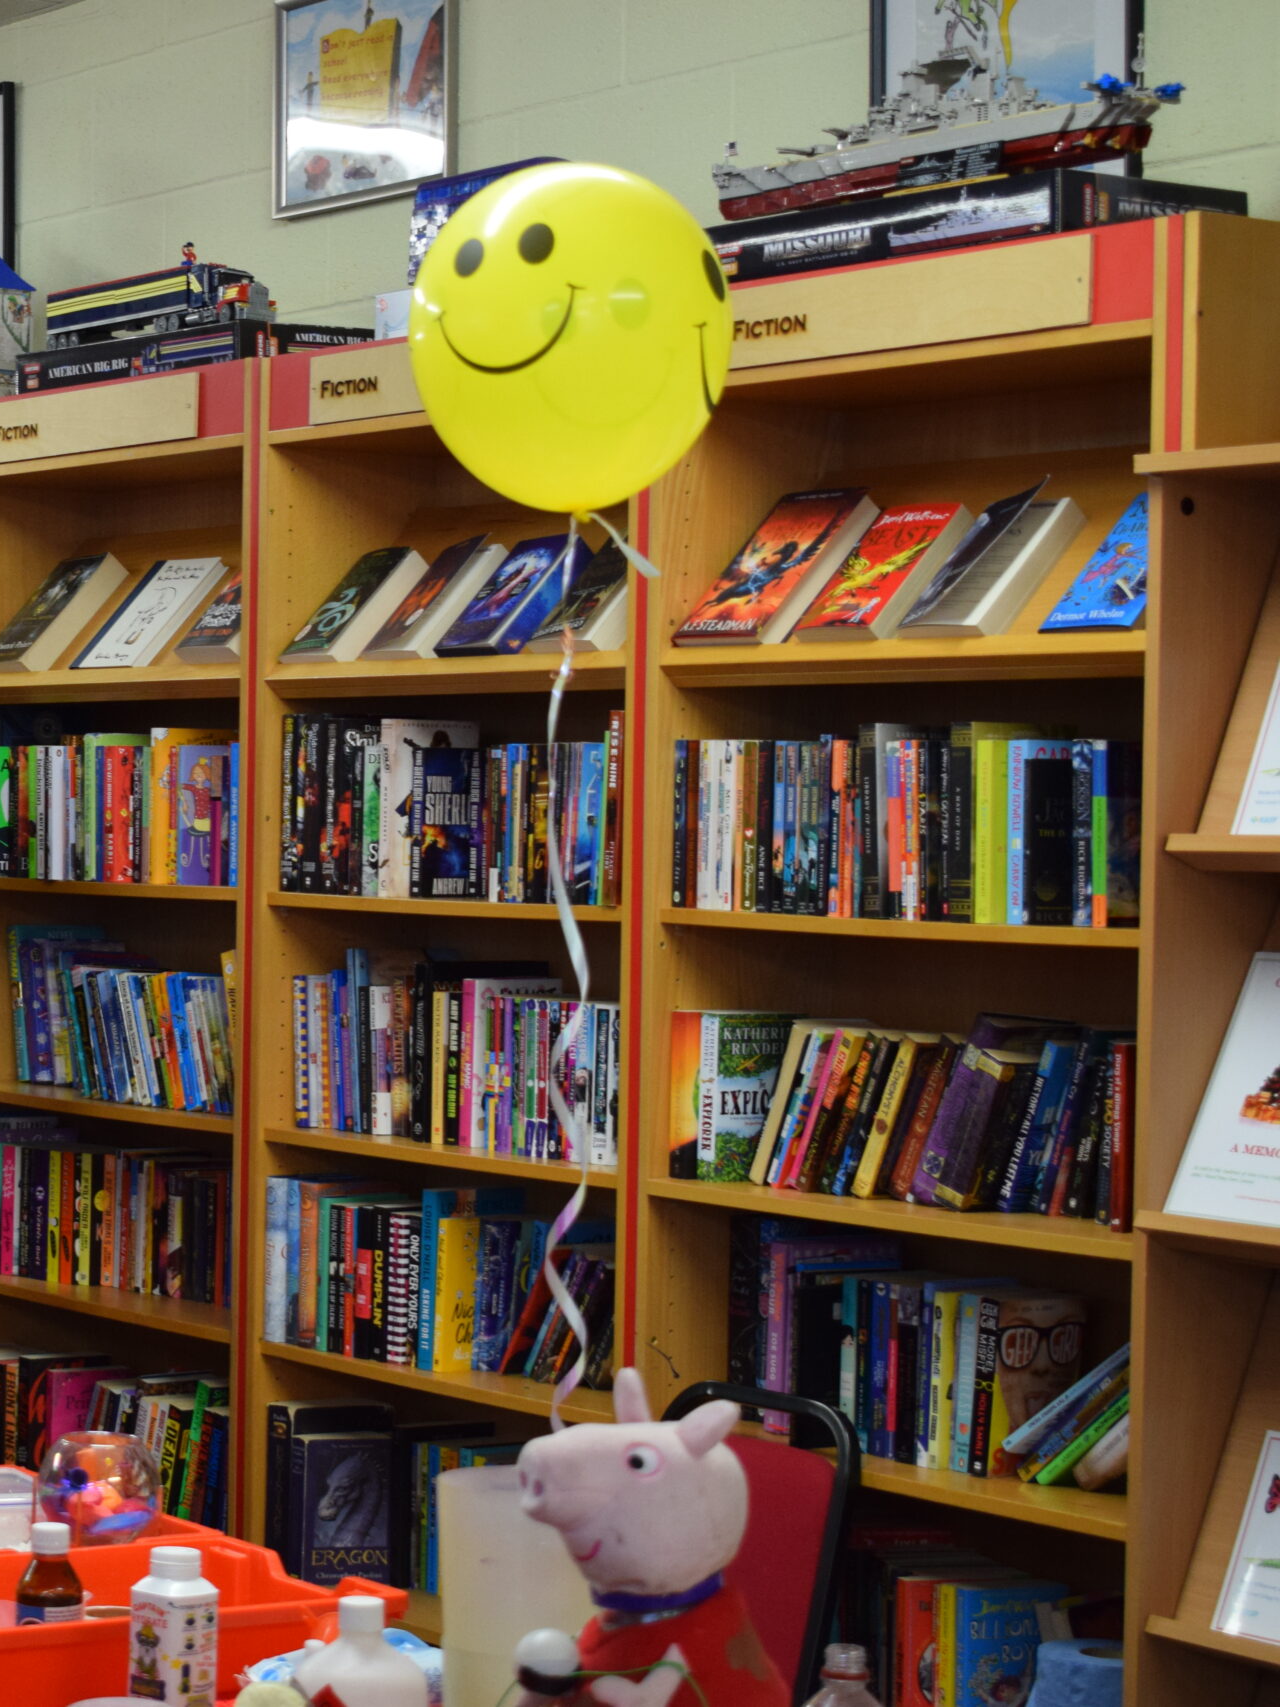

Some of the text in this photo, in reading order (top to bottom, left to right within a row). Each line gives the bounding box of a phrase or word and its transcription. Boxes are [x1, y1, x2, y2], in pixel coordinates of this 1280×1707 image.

[762, 226, 872, 262] MISSOURI
[294, 332, 345, 344] AMERICAN
[733, 315, 808, 341] FICTION
[48, 358, 129, 379] AMERICAN BIG RIG
[320, 376, 378, 399] FICTION
[697, 618, 755, 631] STEADMAN
[608, 719, 619, 789] RISE NINE
[413, 767, 423, 801] SHERLOCK
[426, 775, 453, 793] YOUNG
[471, 768, 480, 803] SHERLOCK
[1012, 745, 1022, 832] RAINBOW ROWELL
[425, 793, 470, 826] SHERL
[864, 814, 871, 825] OF
[955, 816, 961, 827] OF
[229, 786, 238, 870] SUPER AWKWARD
[412, 846, 420, 867] ANDREW
[469, 848, 477, 869] ANDREW
[432, 878, 465, 895] ANDREW
[1077, 841, 1086, 908] RICK RIORDAN
[392, 978, 405, 1074] ANCIENT APPETITES
[449, 999, 459, 1052] ANDY McNAB
[723, 1027, 787, 1042] KATHERI
[852, 1050, 872, 1086] CHRIS
[1113, 1053, 1123, 1076] Diary
[447, 1073, 457, 1118] BOY SOLDIER
[719, 1088, 769, 1116] EXPLO
[917, 1058, 944, 1118] MAGICIAN
[1026, 1076, 1045, 1114] HISTORY
[701, 1094, 713, 1152] EXPLORER
[1102, 1077, 1114, 1168] THE SOCIETY
[1113, 1121, 1121, 1153] Vampire
[1013, 1137, 1026, 1157] YOU
[1229, 1143, 1239, 1153] A
[1005, 1157, 1020, 1179] LEFT
[999, 1179, 1013, 1199] ME
[329, 1208, 338, 1257] BRIAN MOORE
[422, 1203, 432, 1281] LOUISE O'NEILL
[328, 1280, 336, 1294] LIES
[373, 1249, 383, 1328] DUMPLIN'
[407, 1234, 420, 1329] ONLY EVER YOURS
[328, 1303, 336, 1328] SILENCE
[421, 1288, 431, 1350] ASKING FOR IT
[976, 1334, 987, 1373] MISFIT
[986, 1334, 996, 1375] MODEL
[1001, 1327, 1038, 1363] GEEK
[1049, 1325, 1081, 1361] GIRL
[4, 1370, 16, 1462] FRONT LINES
[974, 1392, 987, 1457] HOLLY SMALE
[311, 1548, 388, 1569] ERAGON
